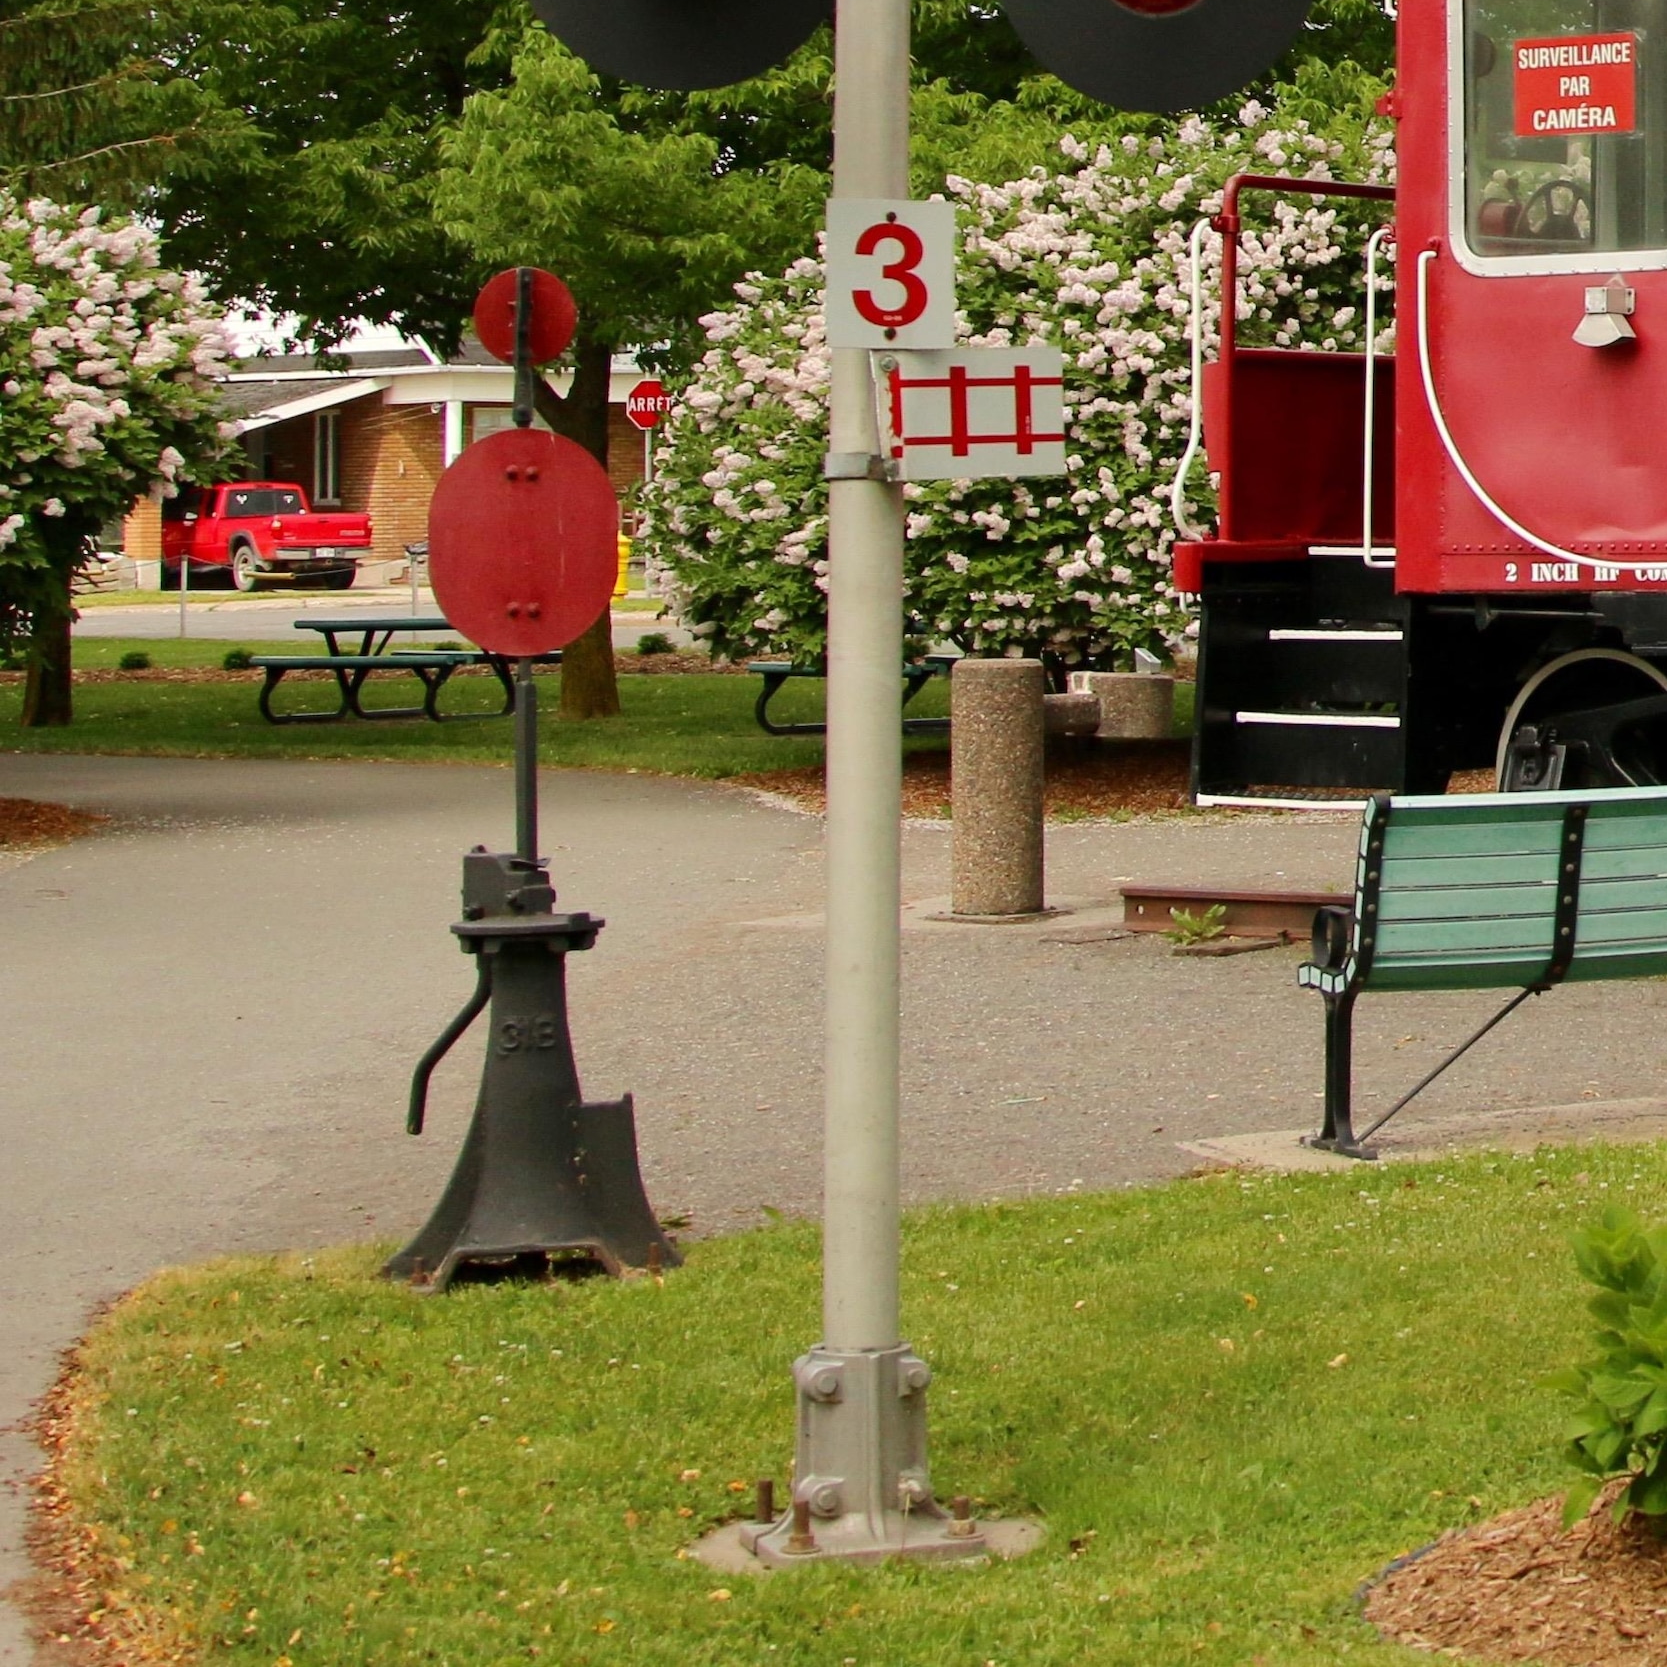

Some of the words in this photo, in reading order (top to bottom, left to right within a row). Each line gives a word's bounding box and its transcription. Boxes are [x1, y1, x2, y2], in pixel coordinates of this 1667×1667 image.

[1518, 42, 1631, 69] SURVEILLANCE
[1559, 75, 1590, 97] PAR
[1532, 103, 1617, 130] CAMÉRA
[852, 223, 928, 327] 3
[629, 396, 671, 412] ARRÊT
[1505, 562, 1517, 582] 2
[1531, 563, 1578, 581] INCH
